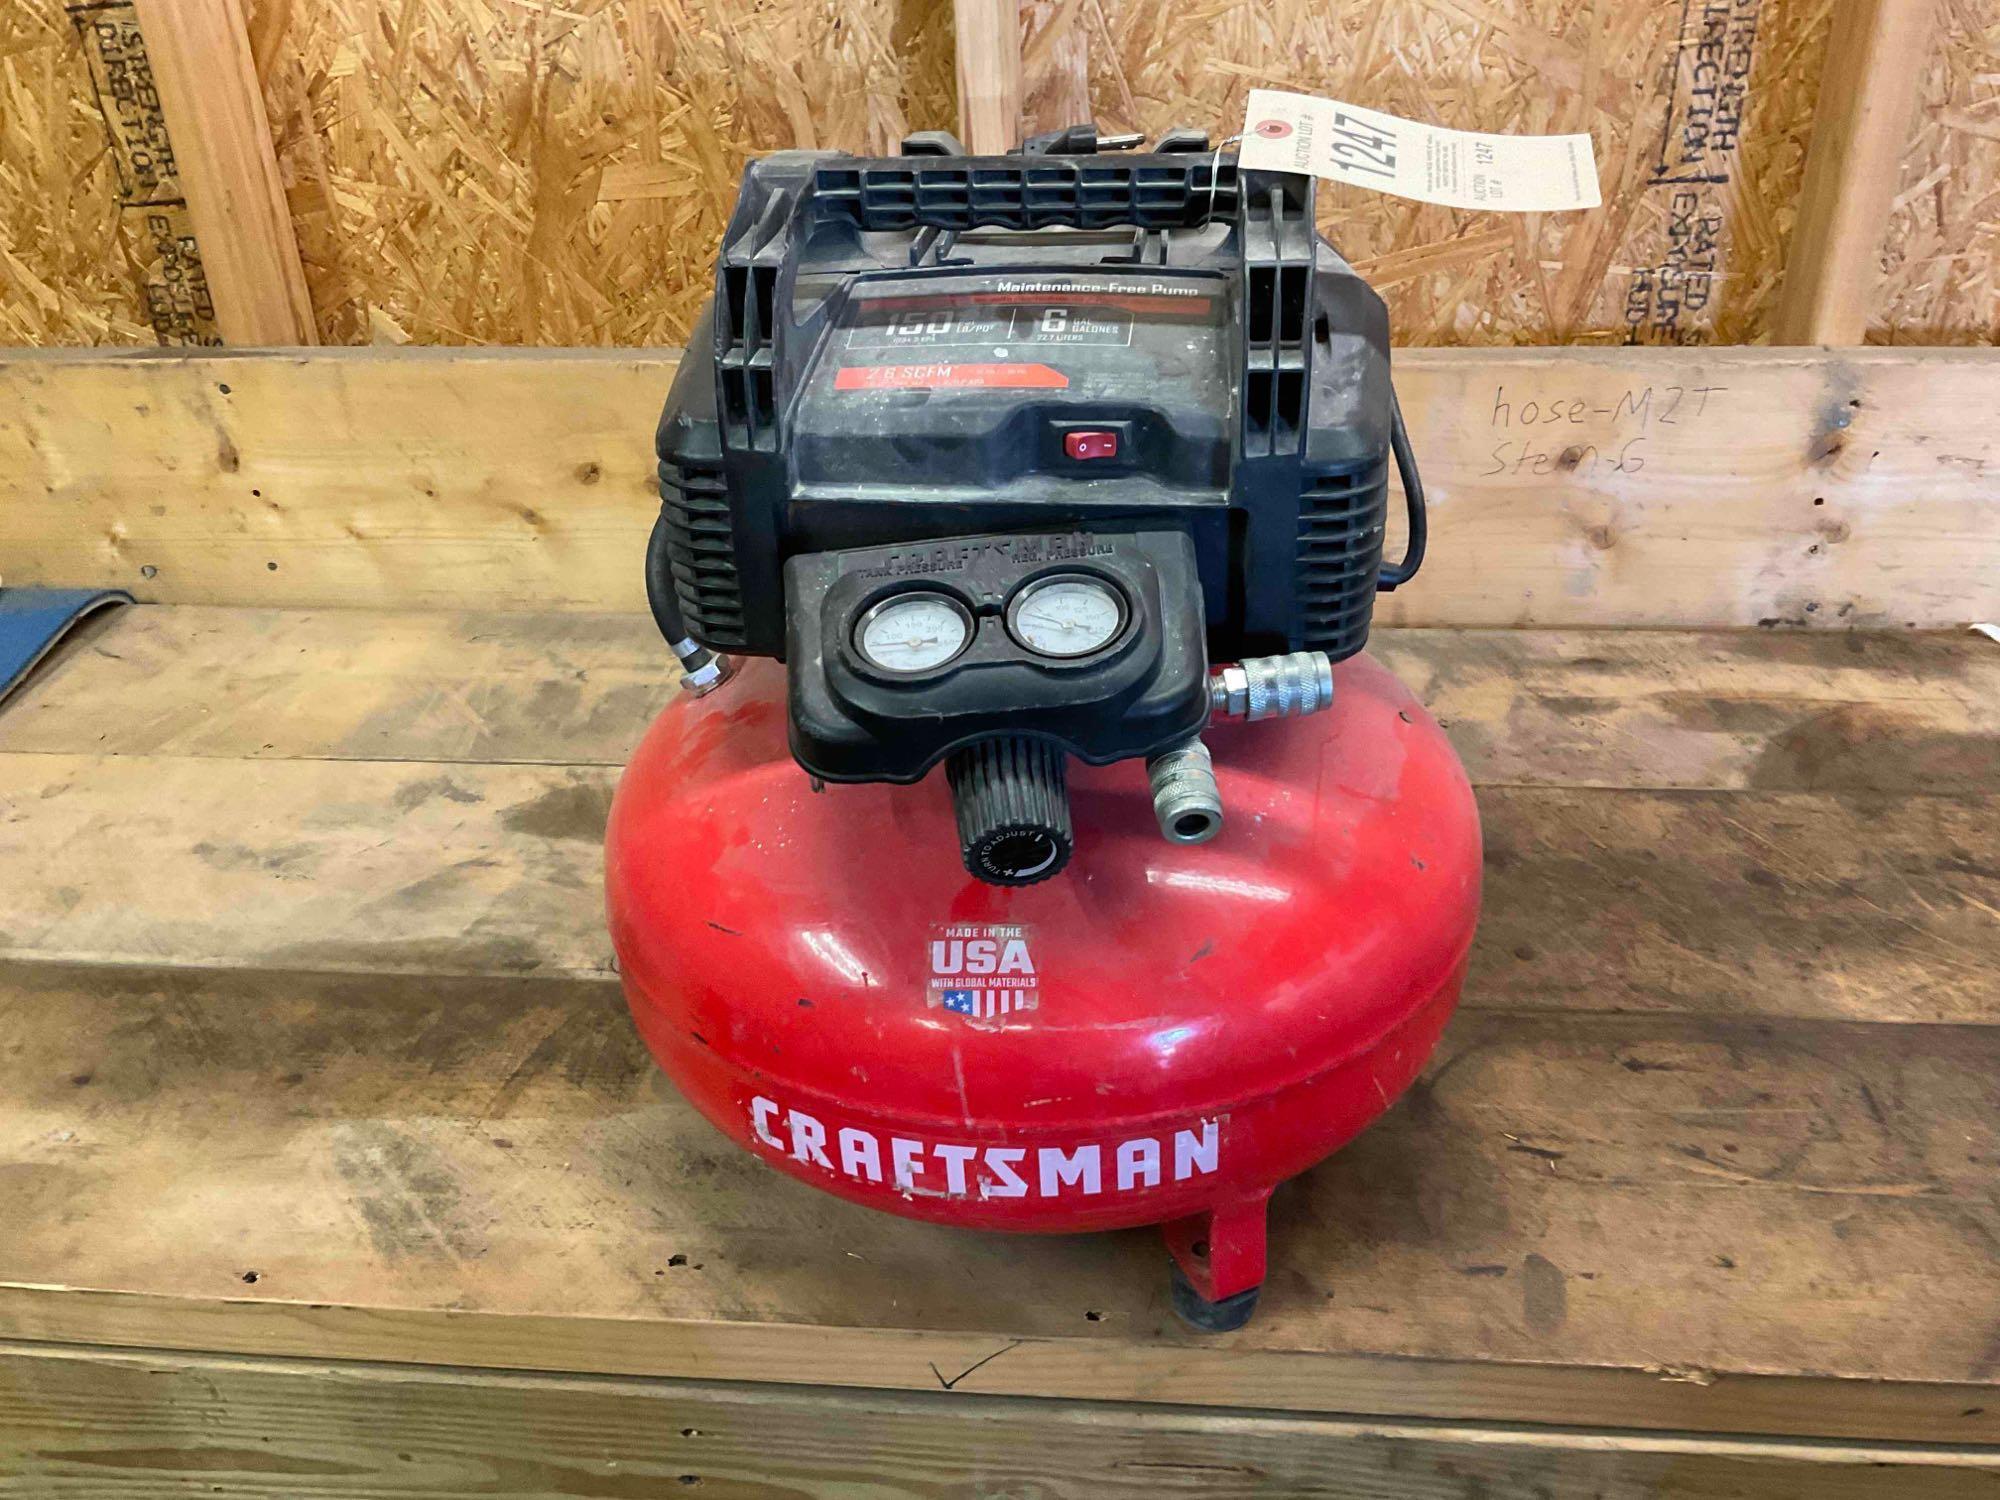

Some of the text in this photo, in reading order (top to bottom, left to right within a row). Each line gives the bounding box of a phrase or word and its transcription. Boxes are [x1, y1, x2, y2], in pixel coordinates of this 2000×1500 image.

[1681, 2, 1730, 163] IRECTION
[1299, 122, 1313, 136] LOT
[1294, 137, 1312, 169] AUCTION
[1329, 112, 1397, 178] 1247
[1475, 142, 1493, 165] 1247
[998, 281, 1199, 297] Maintenance-Free Pump
[885, 311, 954, 336] 150
[1041, 309, 1067, 332] 6
[902, 365, 952, 378] SCFM
[991, 830, 1035, 846] ADJUST
[946, 928, 1022, 937] MADE IN THE
[932, 940, 1035, 974] USA
[931, 977, 1036, 988] WITH GLOBAL MATERIALS
[752, 1095, 1219, 1197] CRAFTSMAN
